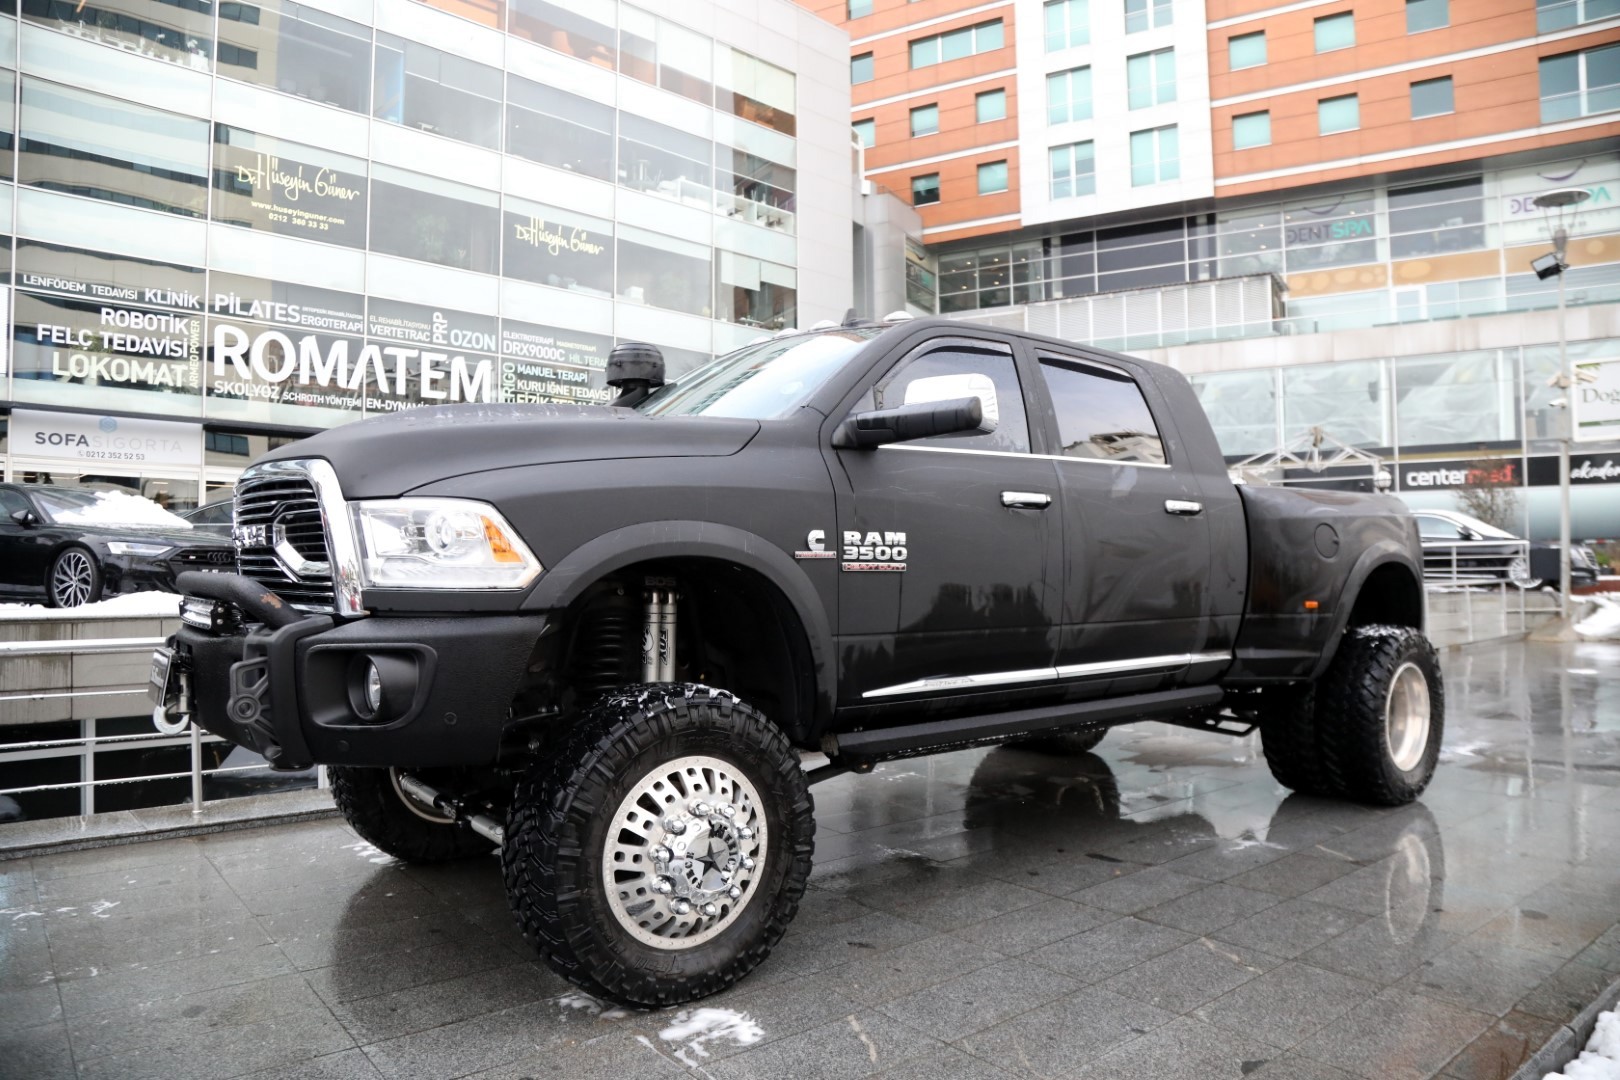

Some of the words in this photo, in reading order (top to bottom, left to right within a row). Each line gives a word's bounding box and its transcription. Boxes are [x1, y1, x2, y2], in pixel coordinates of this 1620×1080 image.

[250, 154, 313, 201] Hüseyin
[314, 166, 360, 201] Güner
[251, 201, 345, 225] www.huseyinguner.com
[269, 212, 287, 223] 0212
[308, 218, 317, 229] 33
[319, 221, 329, 231] 33
[23, 274, 86, 293] LENFÖDEM
[91, 284, 138, 300] TEDAVİSİ
[144, 287, 201, 309] KLİNİK
[214, 292, 300, 323] PİLATES
[100, 307, 189, 335] ROBOTİK
[301, 314, 364, 333] ERGOTERAPİ
[432, 311, 448, 344] PRP
[37, 323, 93, 351] FELÇ
[101, 331, 188, 359] TEDAVİSİ
[190, 320, 201, 352] POWER
[370, 323, 431, 343] VERTETRAC
[450, 329, 496, 351] OZON
[503, 340, 566, 363] DRX9000C
[52, 351, 189, 388] LOKOMAT
[190, 354, 200, 389] ARMEO
[213, 324, 492, 403] ROMATEM
[517, 363, 556, 379] MANUEL
[557, 369, 588, 383] TERAPİ
[214, 380, 279, 400] SKOLYOZ
[283, 391, 324, 404] SCHROTH
[325, 394, 362, 408] YÖNTEMİ
[517, 380, 546, 393] KURU
[547, 380, 570, 396] İĞNE
[571, 386, 611, 401] TEDAVİSİ
[85, 450, 107, 460] 0212
[108, 451, 122, 460] 352
[124, 452, 134, 460] 52
[135, 452, 145, 461] 53
[843, 530, 906, 546] RAM
[843, 546, 908, 561] 3500
